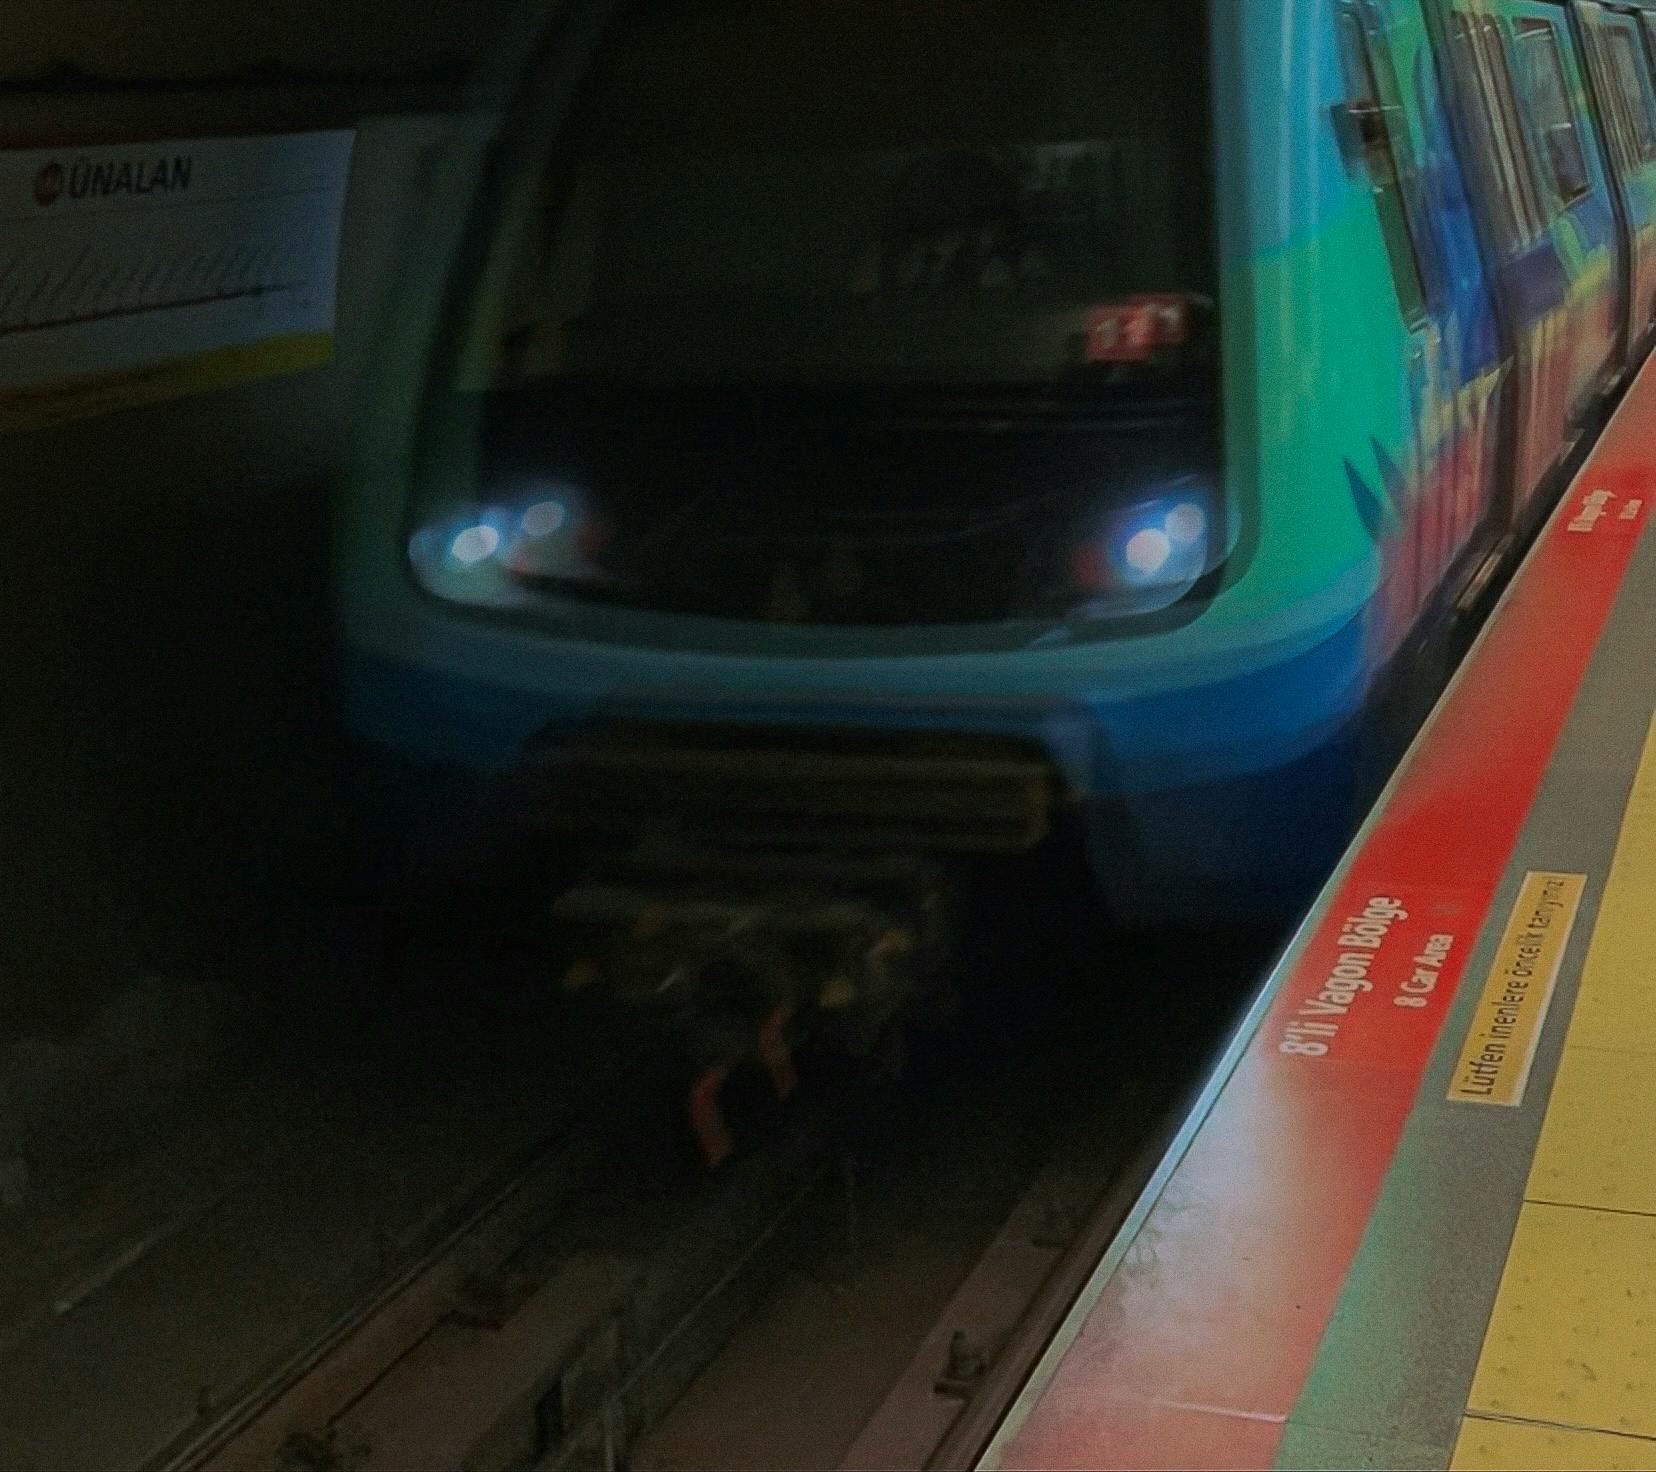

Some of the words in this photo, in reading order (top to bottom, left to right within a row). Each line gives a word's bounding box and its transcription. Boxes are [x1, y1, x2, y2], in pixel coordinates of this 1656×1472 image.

[67, 155, 192, 199] ÜNALAN
[1299, 952, 1375, 1016] Vagon
[1337, 896, 1409, 949] Bölge
[1412, 933, 1454, 968] Area
[1392, 995, 1429, 1009] 8
[1400, 968, 1440, 993] Car
[1480, 979, 1529, 1039] inenlere
[1460, 1043, 1507, 1096] Lütfen
